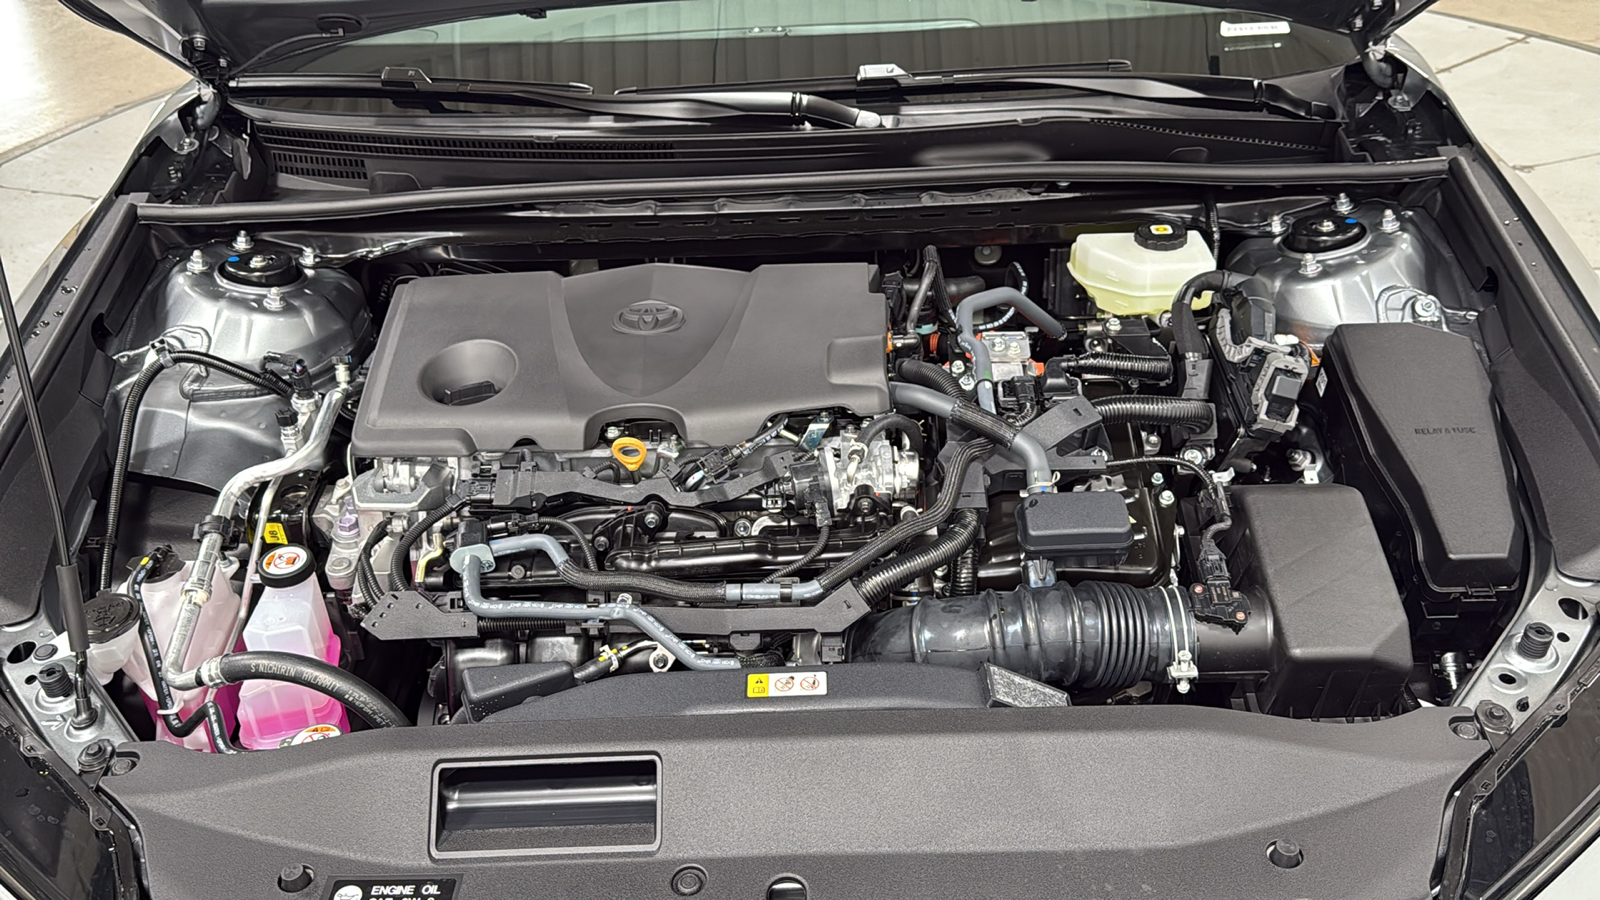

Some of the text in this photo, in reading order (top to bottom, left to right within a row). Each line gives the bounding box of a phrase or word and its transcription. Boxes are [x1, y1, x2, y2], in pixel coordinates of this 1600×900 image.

[1414, 427, 1443, 435] RELAY
[1451, 426, 1477, 434] FUSE
[371, 884, 441, 896] ENGINE OIL
